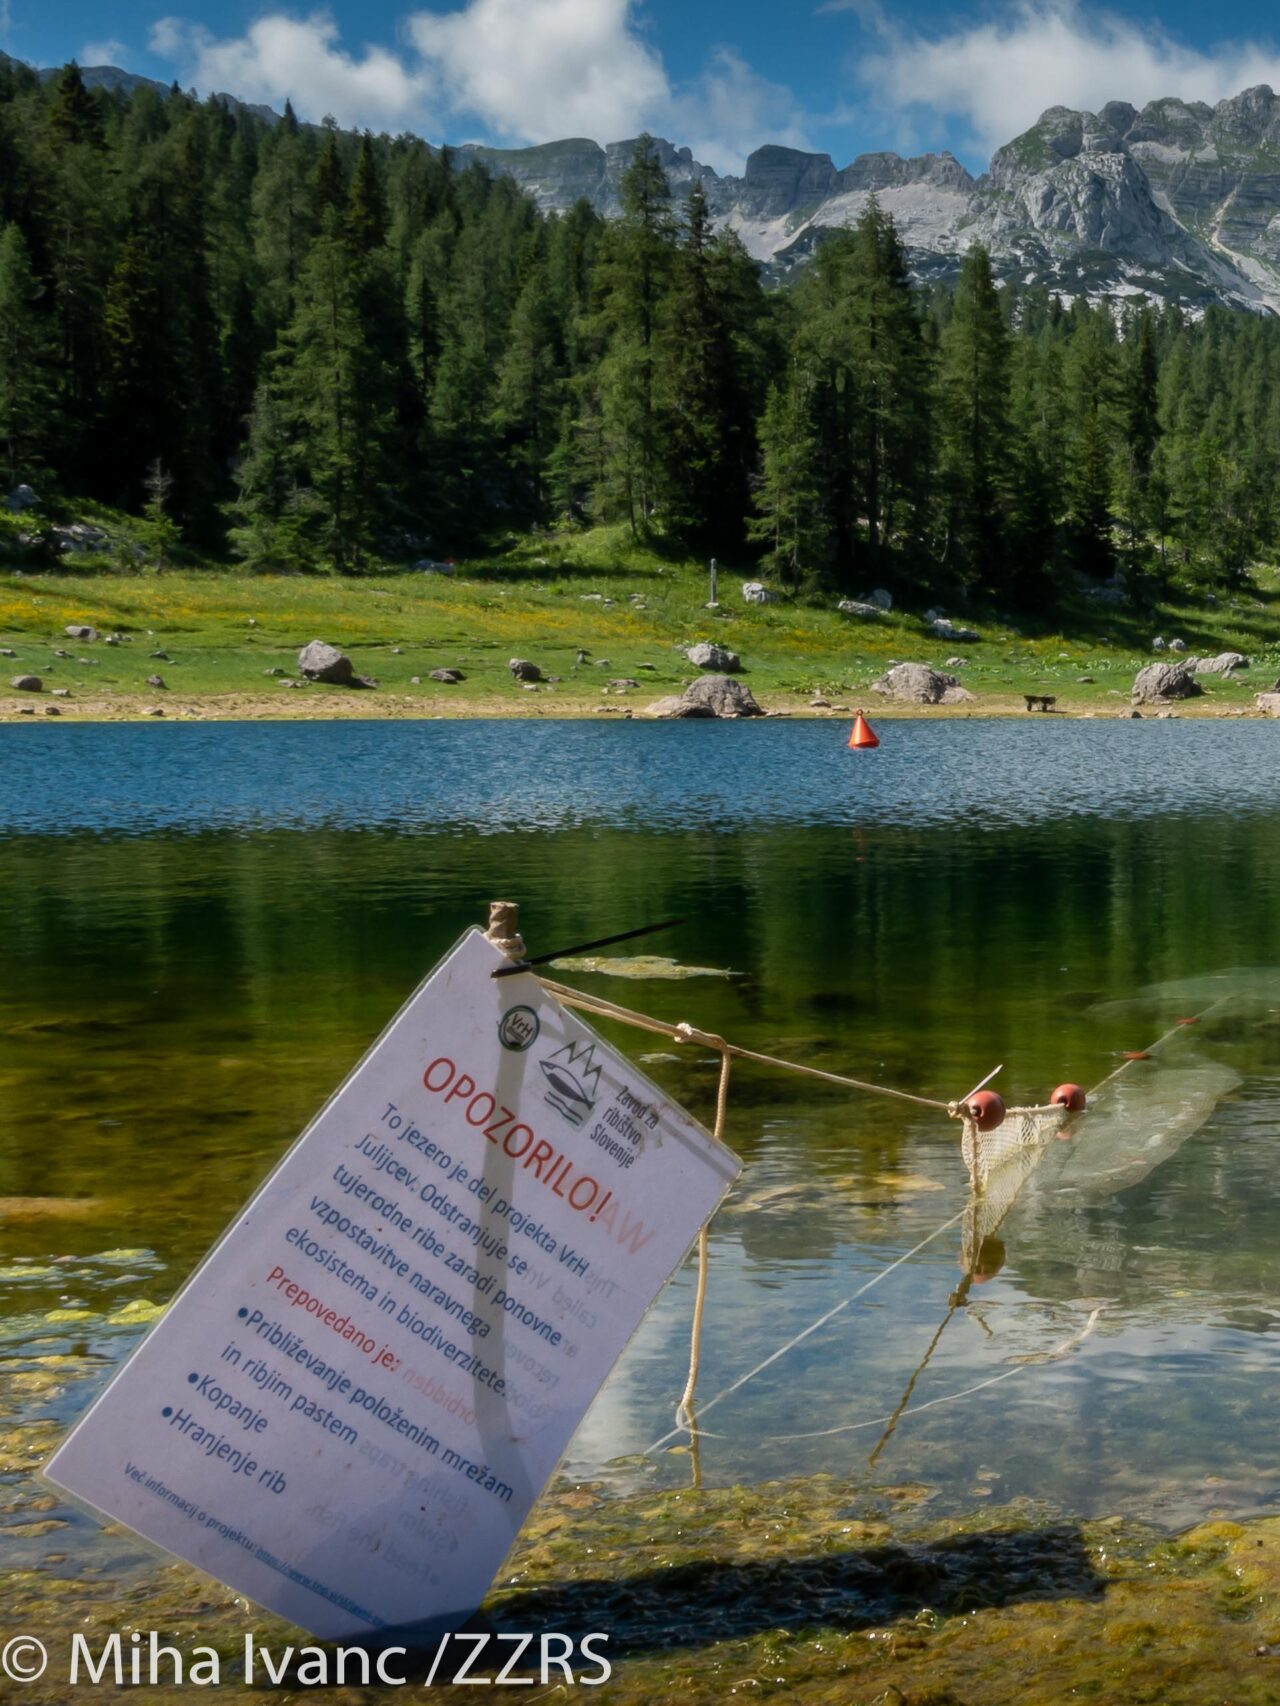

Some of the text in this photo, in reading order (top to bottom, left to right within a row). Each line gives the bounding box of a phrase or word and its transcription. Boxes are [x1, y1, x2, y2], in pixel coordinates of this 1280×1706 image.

[511, 1013, 534, 1038] VrH
[422, 1056, 612, 1222] OPOZORILO!
[589, 1122, 638, 1168] Slovenije
[601, 1106, 642, 1145] ribištvo
[615, 1084, 661, 1129] Zavod za
[353, 1133, 528, 1275] Julijcev. Odstranjuje se
[380, 1101, 402, 1129] To
[396, 1120, 451, 1169] jezero
[445, 1160, 468, 1183] je
[467, 1177, 498, 1204] del
[490, 1198, 557, 1253] projekta
[558, 1243, 590, 1277] VrH
[309, 1195, 491, 1338] vzpostavitve naravnega
[332, 1163, 562, 1346] tujerodne ribe zaradi ponovne
[265, 1265, 401, 1372] Prepovedano je:
[285, 1227, 378, 1301] ekosistema
[377, 1290, 396, 1314] in
[395, 1303, 505, 1397] biodiverzitete.
[195, 1374, 268, 1433] Kopanje
[220, 1340, 358, 1445] in ribjim pastem
[244, 1309, 513, 1501] Približevanje položenim mrežam
[169, 1407, 286, 1494] Hranjenje rib
[124, 1461, 257, 1553] Več informacij o projektu:
